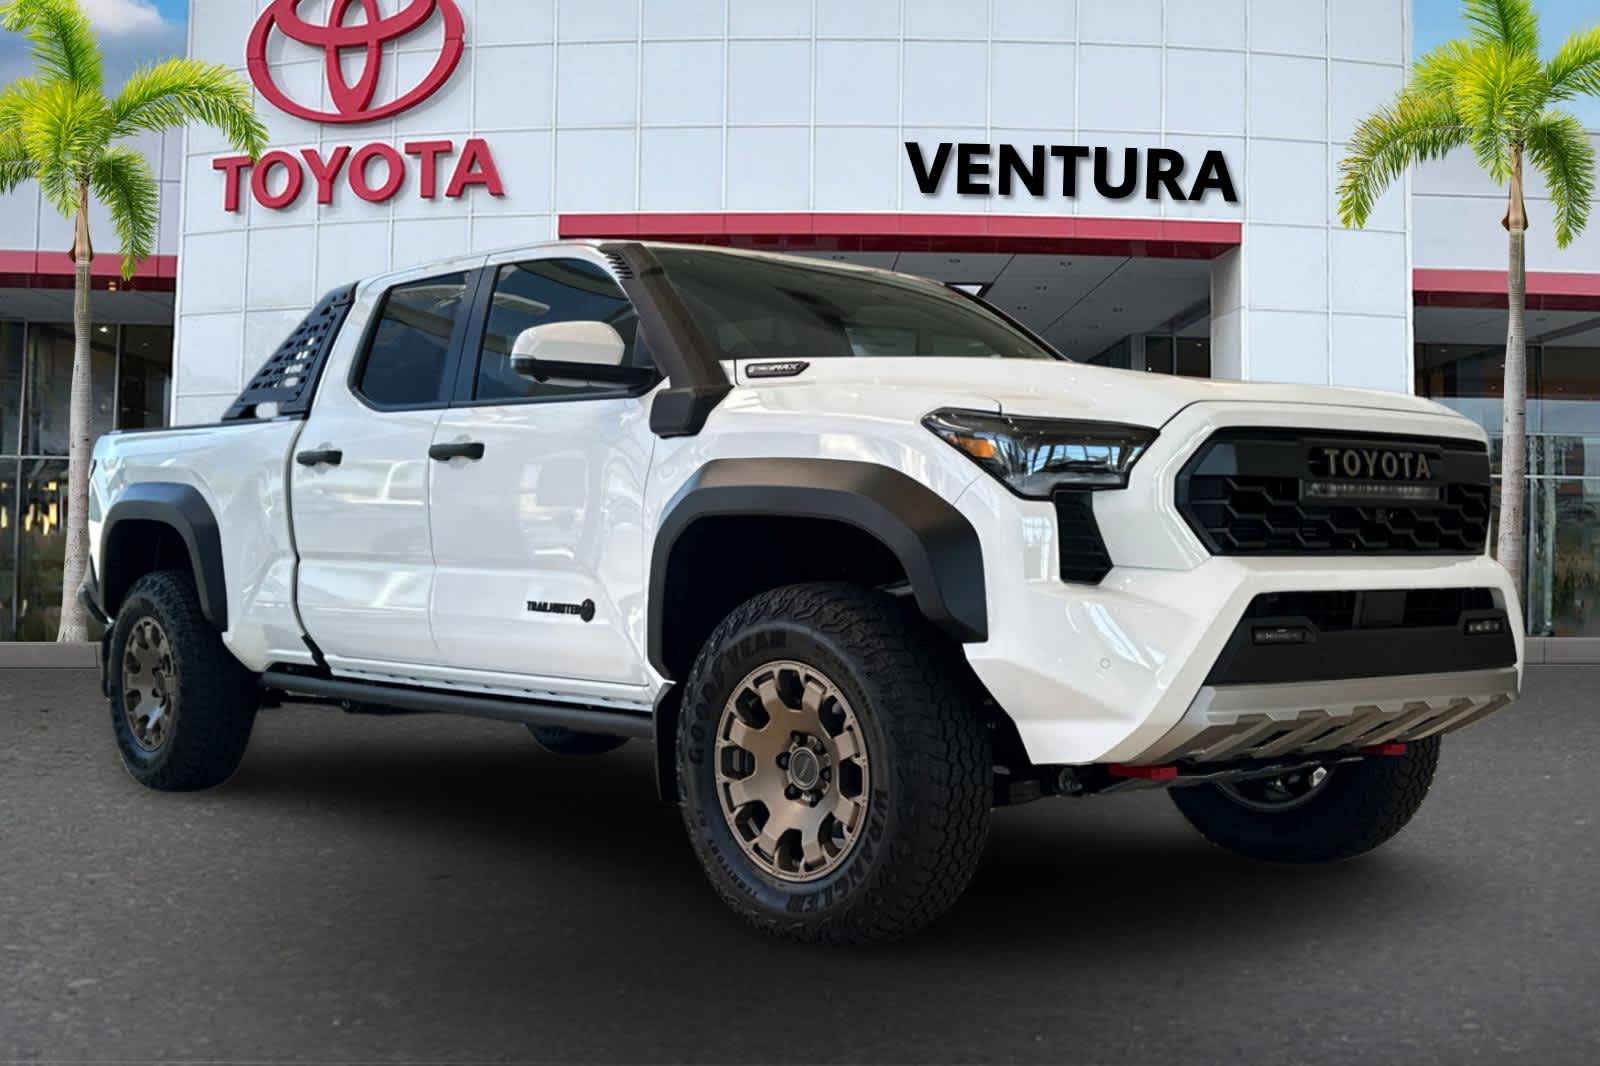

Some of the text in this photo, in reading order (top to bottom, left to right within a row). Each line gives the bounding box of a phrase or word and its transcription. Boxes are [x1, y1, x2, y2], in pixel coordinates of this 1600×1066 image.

[213, 138, 504, 212] TOYOTA
[905, 142, 1238, 202] VENTURA
[1324, 449, 1432, 479] TOYOTA
